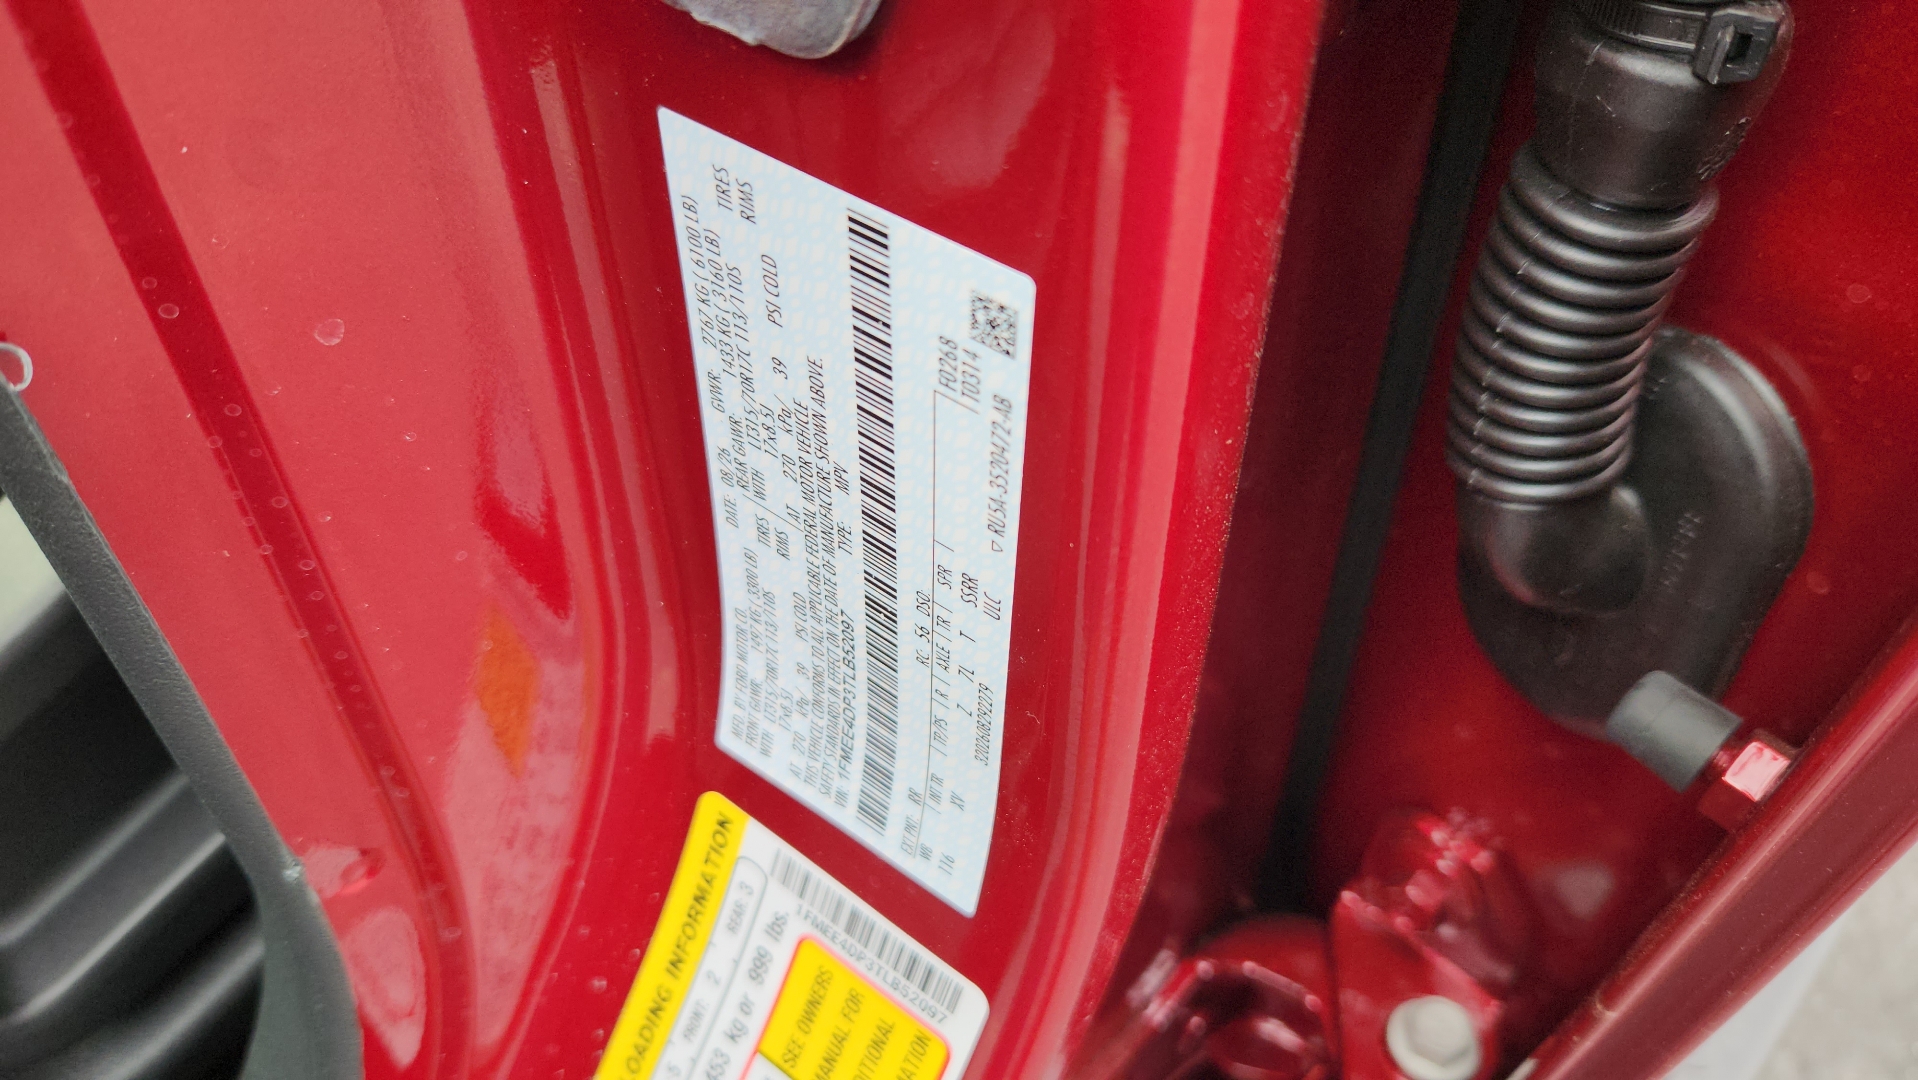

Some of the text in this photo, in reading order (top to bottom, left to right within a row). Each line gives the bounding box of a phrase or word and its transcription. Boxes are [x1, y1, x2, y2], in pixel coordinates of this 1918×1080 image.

[681, 194, 700, 224] LB)
[712, 164, 733, 212] TIRES
[735, 178, 757, 225] RIMS
[685, 225, 706, 270] 6100
[703, 228, 721, 257] LB)
[694, 282, 711, 308] KG
[707, 258, 727, 303] 3160
[697, 307, 717, 350] 2767
[715, 314, 732, 339] KG
[718, 339, 737, 378] 1433
[725, 262, 767, 502] WITH LT315/70R17C 113/110S
[707, 368, 725, 414] GVWR:
[760, 254, 802, 525] AT 270 kPa/ 39 PSI COLD
[728, 413, 746, 457] GAWR:
[759, 402, 779, 459] 17x8.5J
[716, 445, 740, 529] DATE: 08/26
[733, 457, 751, 493] REAR
[754, 513, 772, 548] TIRES
[833, 460, 853, 556] TYPE: MPV
[983, 394, 1012, 621] ULC RU5A-3520472-AB
[743, 546, 758, 569] LB)
[774, 527, 791, 561] RIMS
[745, 567, 761, 600] 3300
[792, 397, 825, 789] THIS VEHICLE CONFORMS TO ALL APPLICABLE FEDERAL MOTOR VEHICLE
[806, 355, 841, 799] SAFETY STANDARDS IN EFFECT ON THE DATE OF MANUFACTURE SHOWN ABOVE.
[748, 606, 762, 626] KG
[749, 623, 764, 654] 1497
[914, 589, 931, 668] RC: 56 DSO:
[731, 607, 748, 741] MFD. BY FORD MOTOR CO.
[748, 678, 763, 713] GAWR:
[759, 587, 779, 758] WITH LT315/70R17C 113/110S
[788, 591, 810, 780] AT 270 kPa/ 39 PSI COLD
[744, 711, 760, 750] FRONT
[778, 687, 794, 732] 17x8.5J
[833, 608, 856, 808] VIN: 1FMEE4DP3TLB52097
[918, 564, 953, 861] WB INT TR TP/PS R AXLE TR SPR
[937, 572, 979, 876] 116 XV Z 7L T SSRR
[974, 682, 994, 767] 3202608292279
[900, 786, 923, 856] EXT PNT: RR
[620, 811, 733, 1080] OADING INFORMATION
[707, 970, 721, 986] 2
[739, 881, 755, 896] 3
[724, 1018, 750, 1044] kg
[739, 992, 755, 1016] or
[747, 945, 775, 986] 999
[764, 910, 790, 943] lbs.
[796, 903, 948, 1024] 1FMEE4DP3TLB52097
[782, 964, 834, 1069] SEE OWNERS
[840, 988, 866, 1024] FOR
